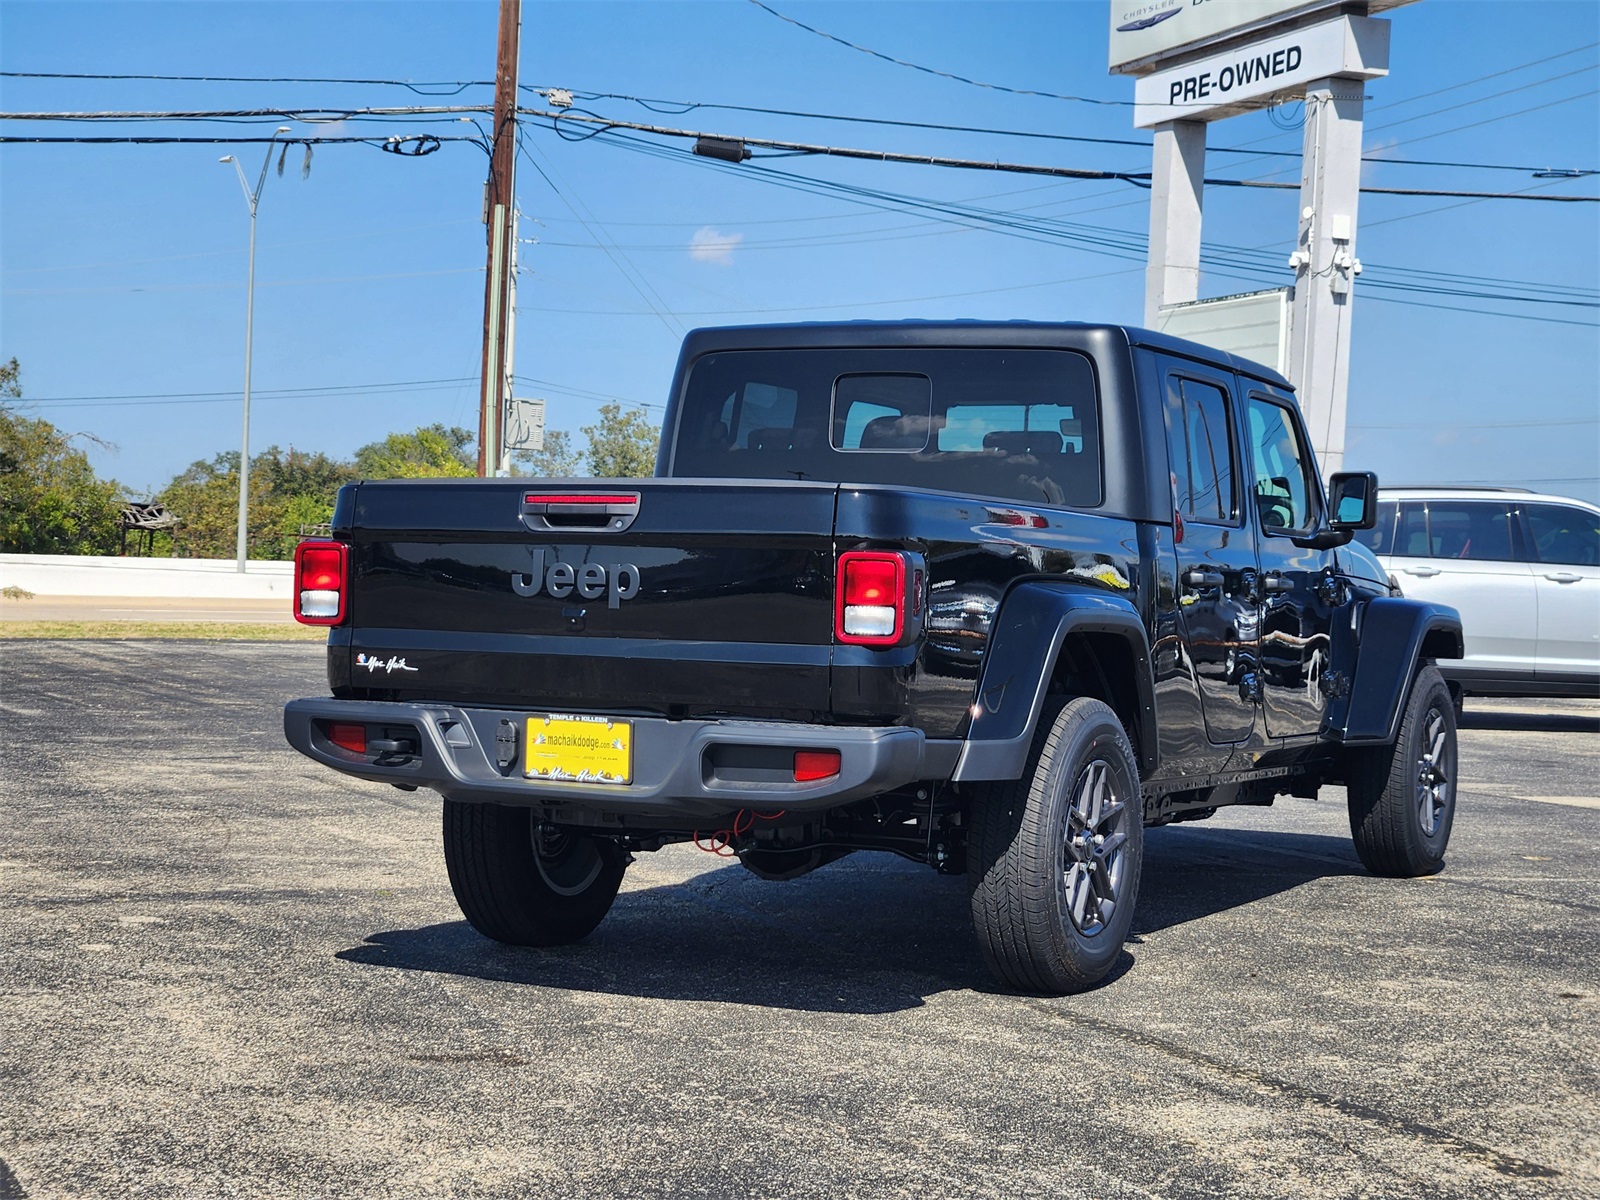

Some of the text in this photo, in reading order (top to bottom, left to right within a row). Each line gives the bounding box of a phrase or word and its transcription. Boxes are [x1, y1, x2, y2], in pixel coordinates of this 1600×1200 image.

[1123, 0, 1175, 20] CHRYSLER
[1169, 45, 1302, 105] PRE-OWNED
[511, 549, 641, 609] Jeep
[581, 715, 608, 723] KILLEEN
[547, 734, 611, 751] machaikdodge.com
[547, 766, 608, 783] Mac Haik
